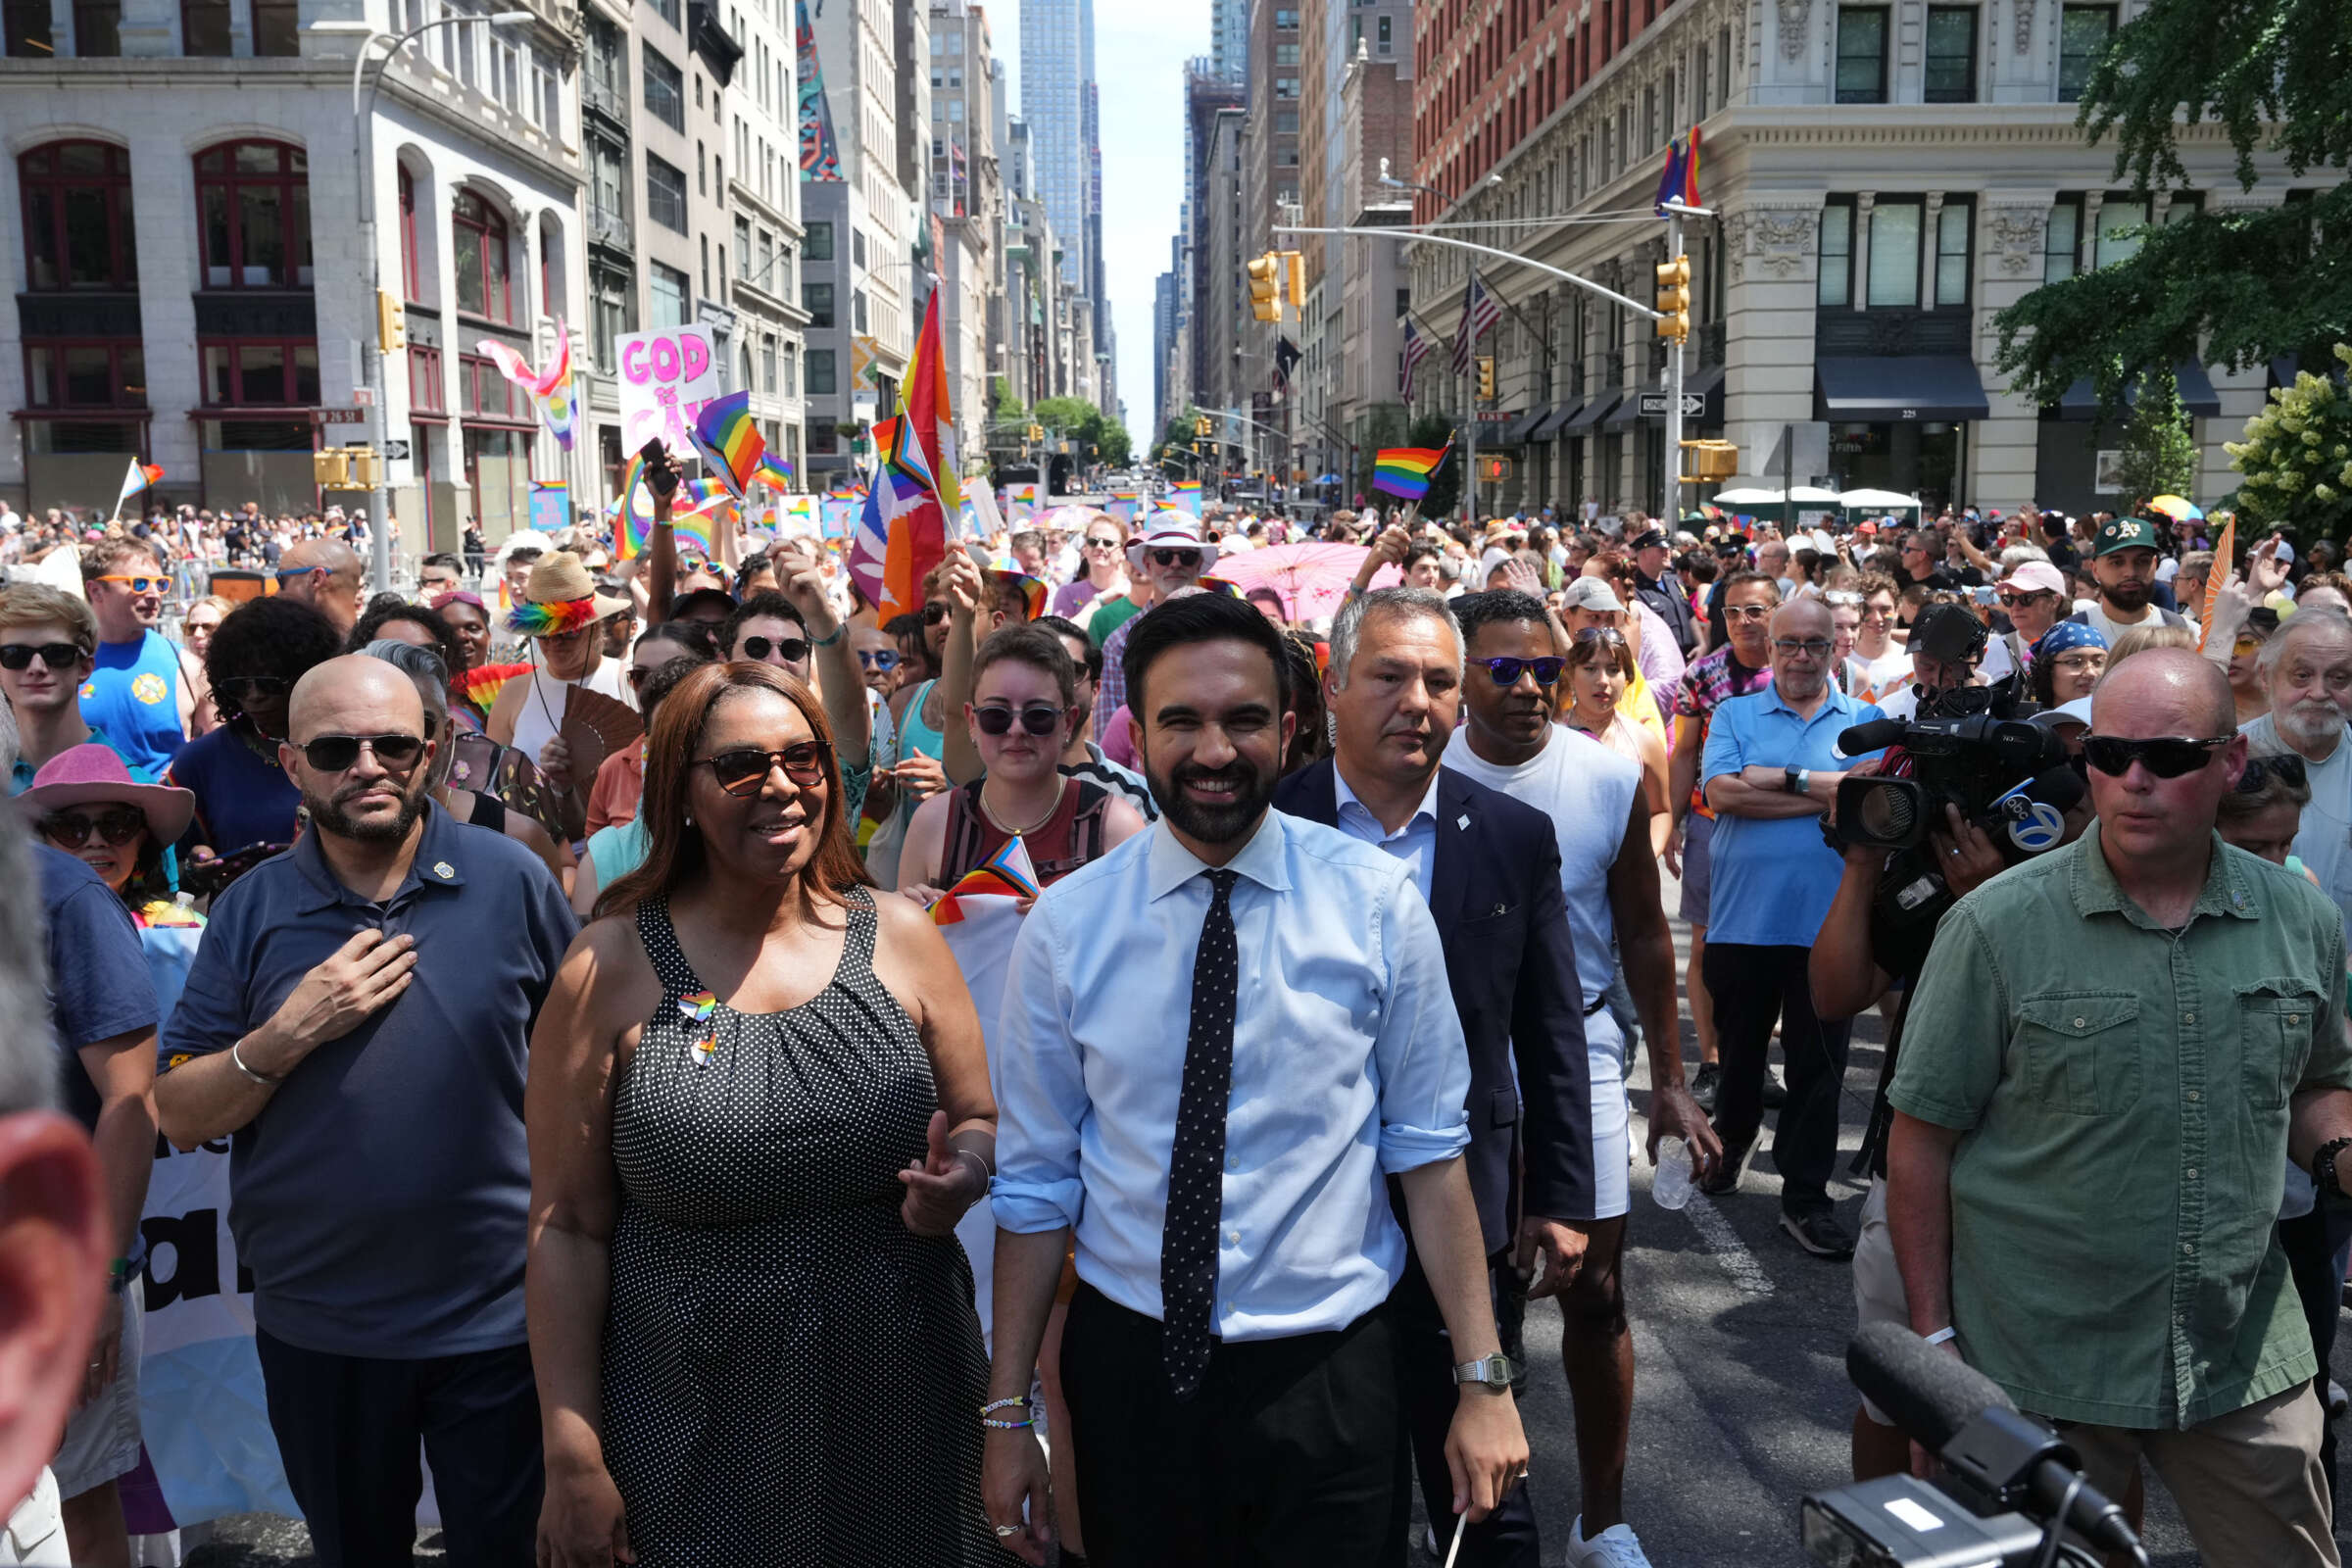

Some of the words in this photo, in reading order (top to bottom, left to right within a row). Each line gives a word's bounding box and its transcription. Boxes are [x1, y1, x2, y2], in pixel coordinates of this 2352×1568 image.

[622, 332, 710, 386] GOD
[1645, 399, 1664, 410] ONE
[318, 412, 327, 423] W
[331, 412, 342, 423] 26
[1902, 410, 1917, 418] 225
[1835, 442, 1862, 453] Fifth
[2117, 519, 2141, 540] A's
[2007, 798, 2030, 820] abc
